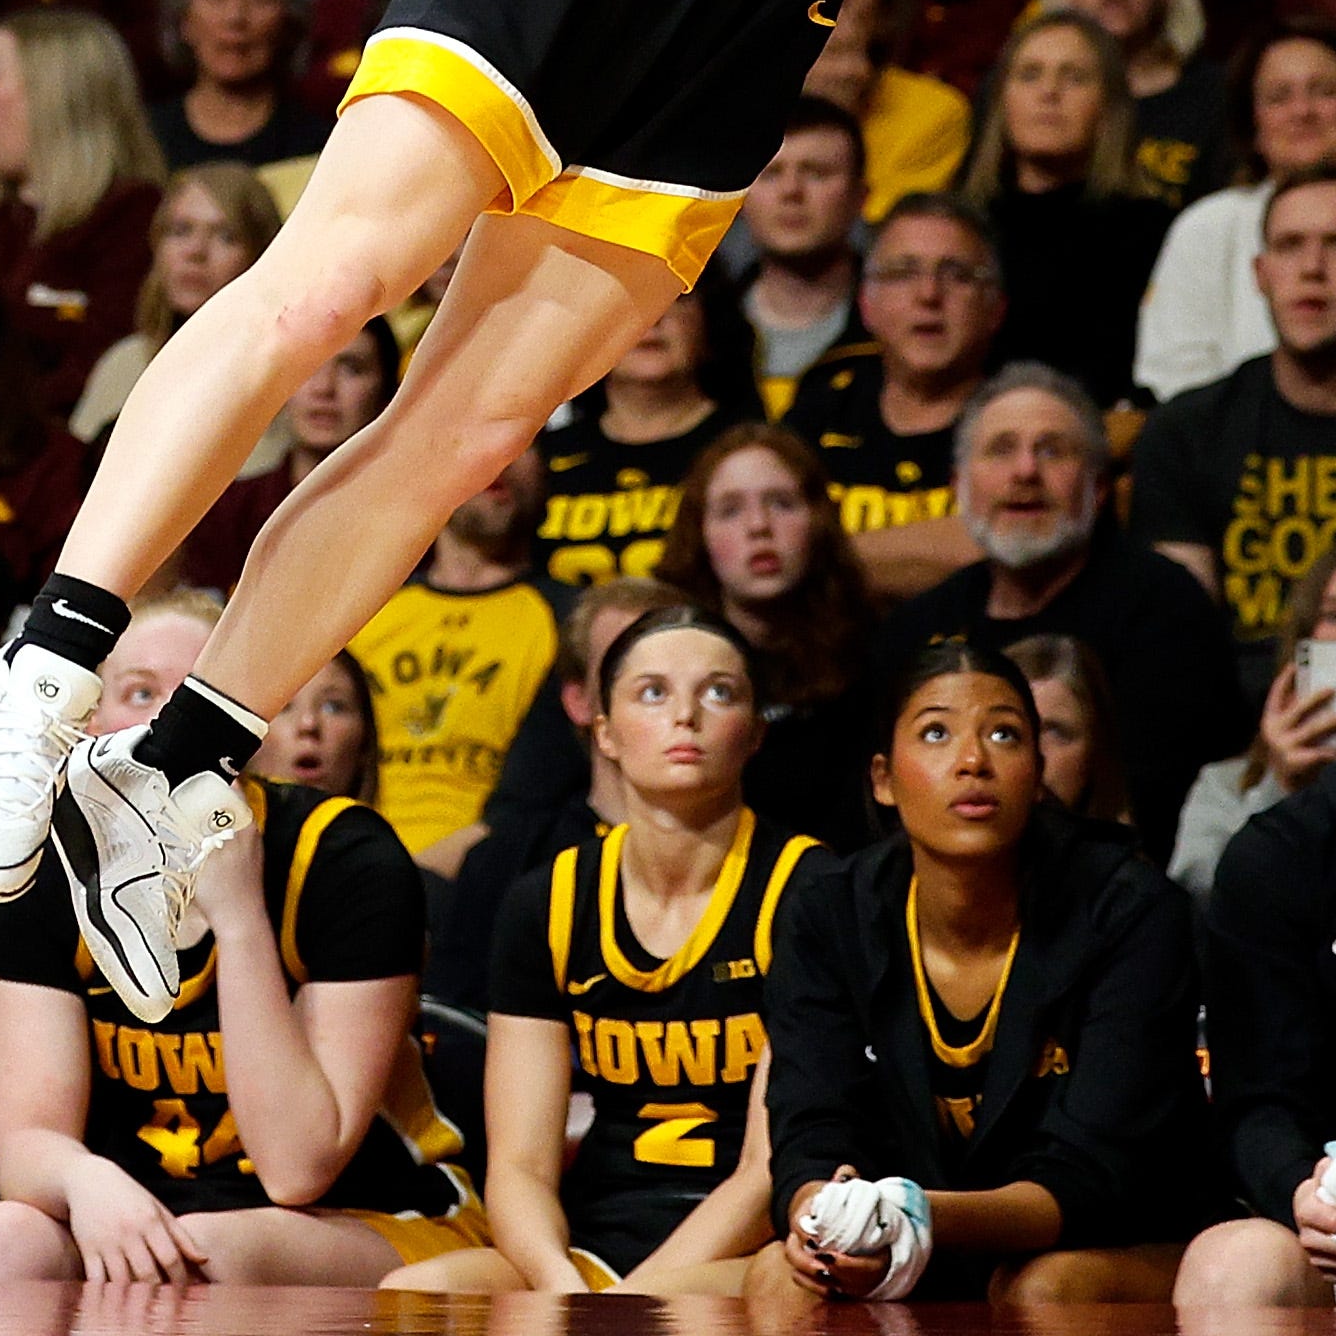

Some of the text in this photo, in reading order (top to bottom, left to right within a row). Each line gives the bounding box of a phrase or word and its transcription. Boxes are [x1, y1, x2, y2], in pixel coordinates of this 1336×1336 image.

[536, 483, 687, 541] IOW
[91, 1017, 227, 1095] IOW
[572, 1009, 767, 1087] IOWA
[632, 1101, 720, 1168] 2
